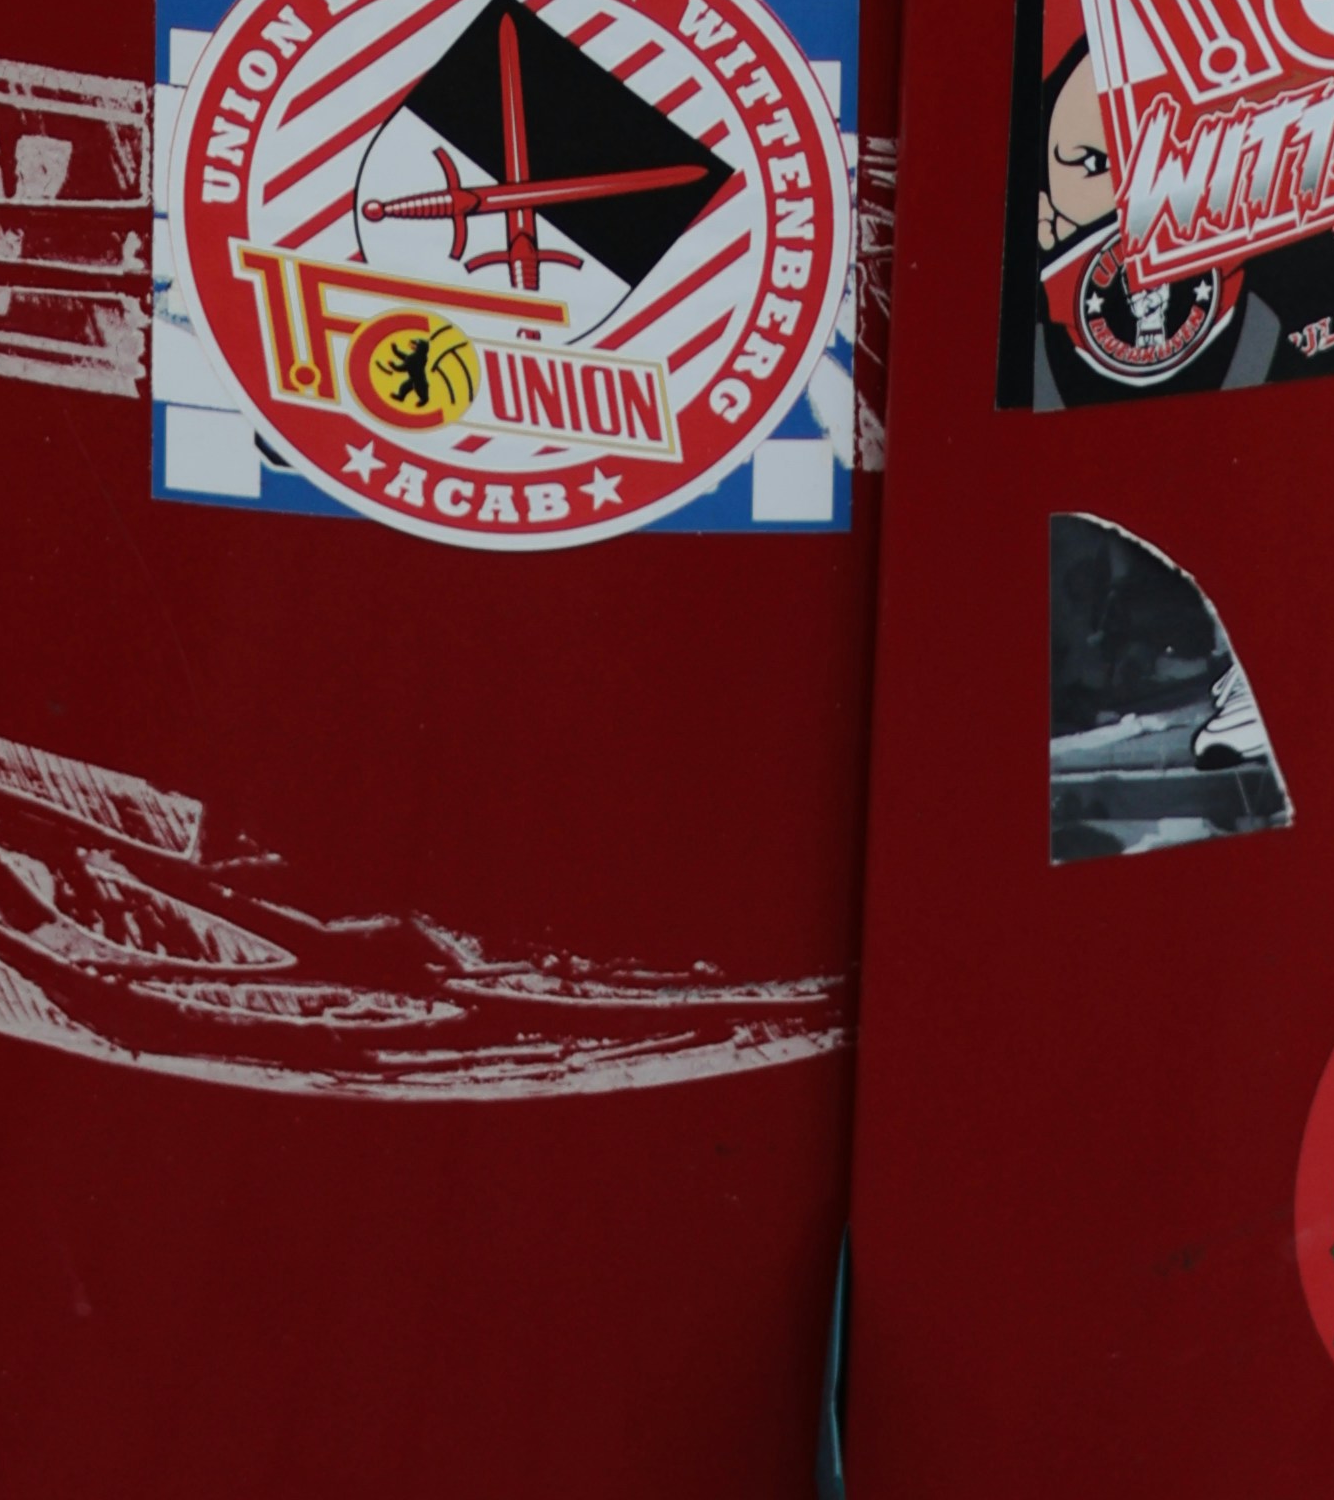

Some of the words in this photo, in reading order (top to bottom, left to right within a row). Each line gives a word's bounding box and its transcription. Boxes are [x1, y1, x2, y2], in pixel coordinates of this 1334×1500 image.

[201, 8, 316, 206] UNION
[483, 348, 664, 443] UNION
[383, 463, 572, 525] ACAB
